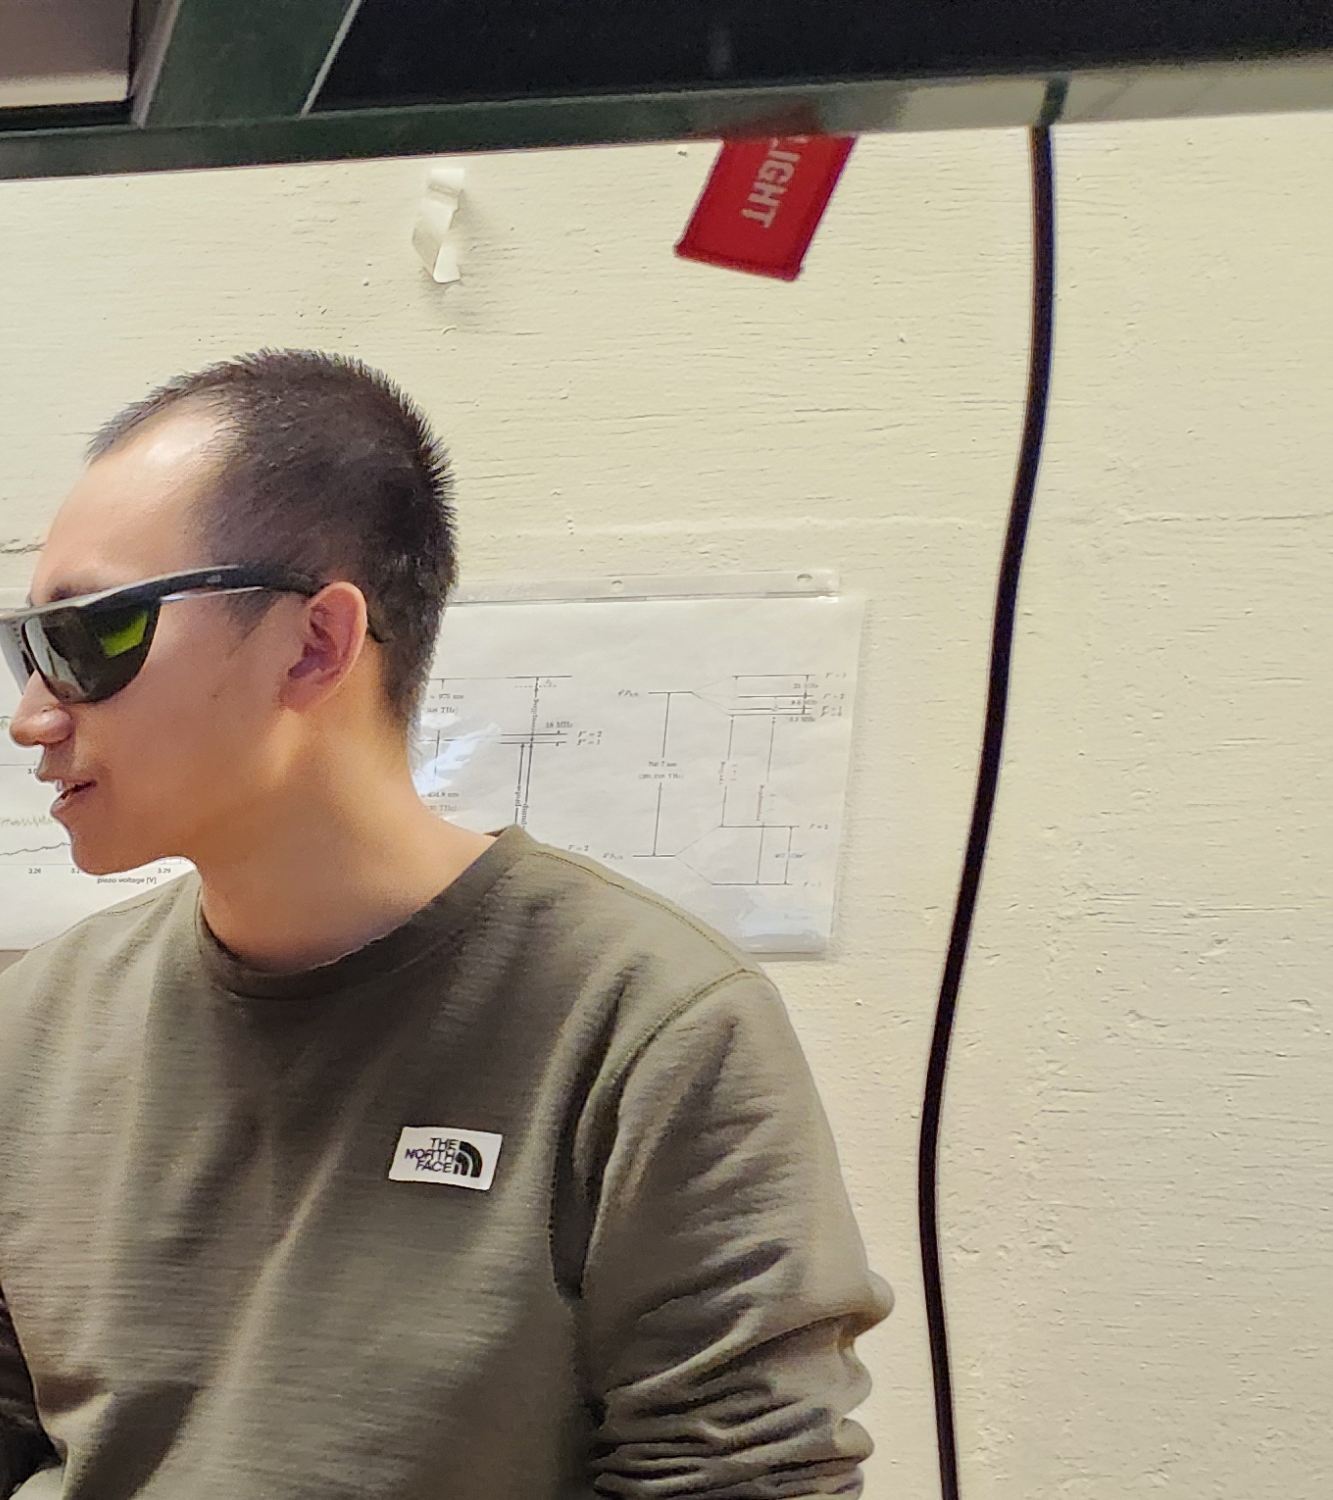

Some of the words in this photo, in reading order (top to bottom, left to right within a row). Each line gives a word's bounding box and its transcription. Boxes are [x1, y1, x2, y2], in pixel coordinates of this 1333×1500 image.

[118, 877, 145, 885] voltage
[430, 1137, 459, 1151] THE
[404, 1148, 456, 1163] NORTH
[415, 1160, 453, 1174] FACE
